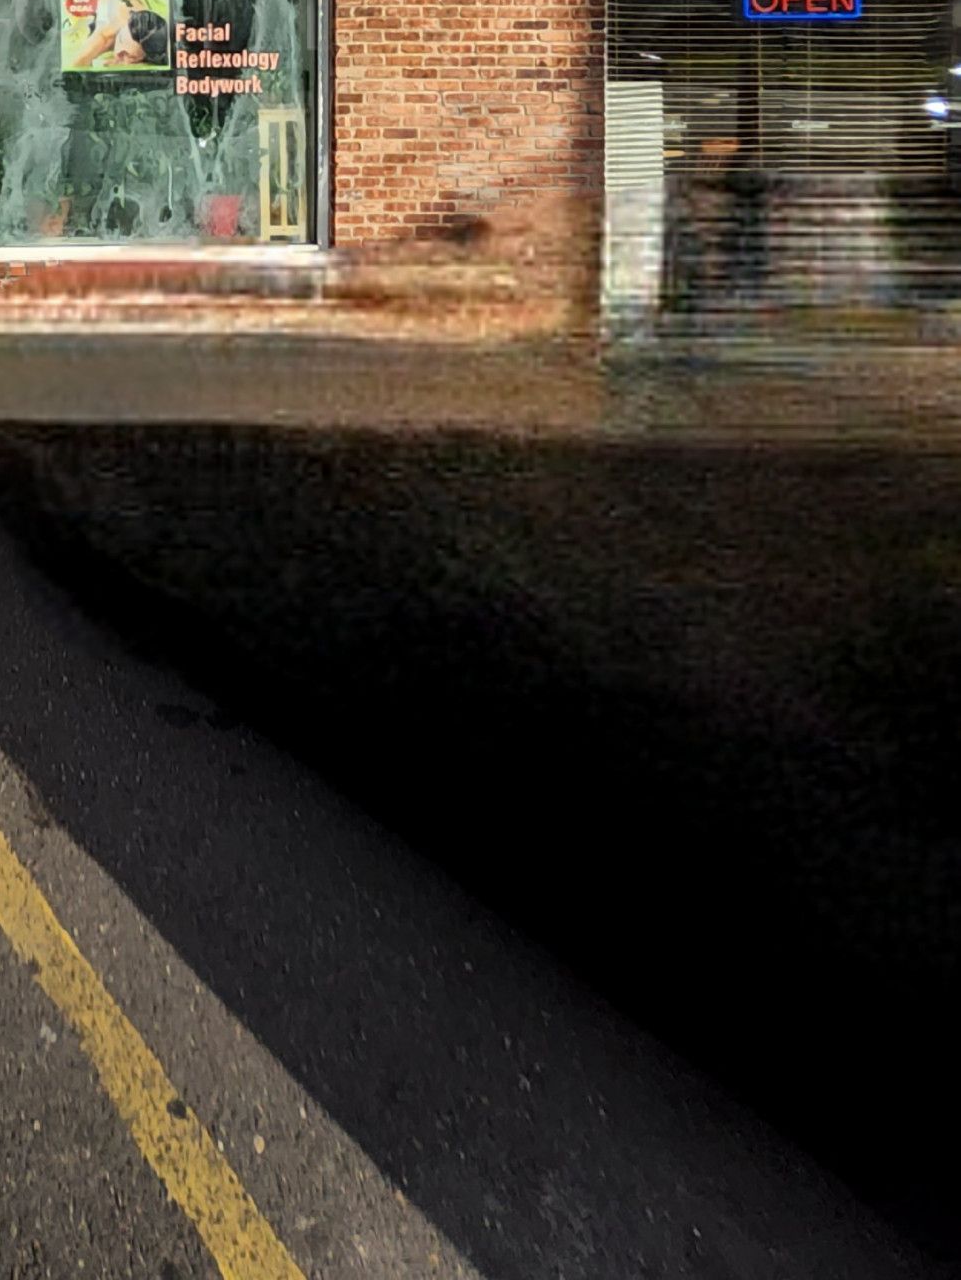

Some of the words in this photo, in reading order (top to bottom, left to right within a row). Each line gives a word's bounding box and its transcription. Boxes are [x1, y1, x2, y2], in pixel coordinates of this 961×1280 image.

[176, 23, 230, 41] Facial
[176, 49, 279, 70] Reflexology
[176, 75, 262, 97] Bodywork
